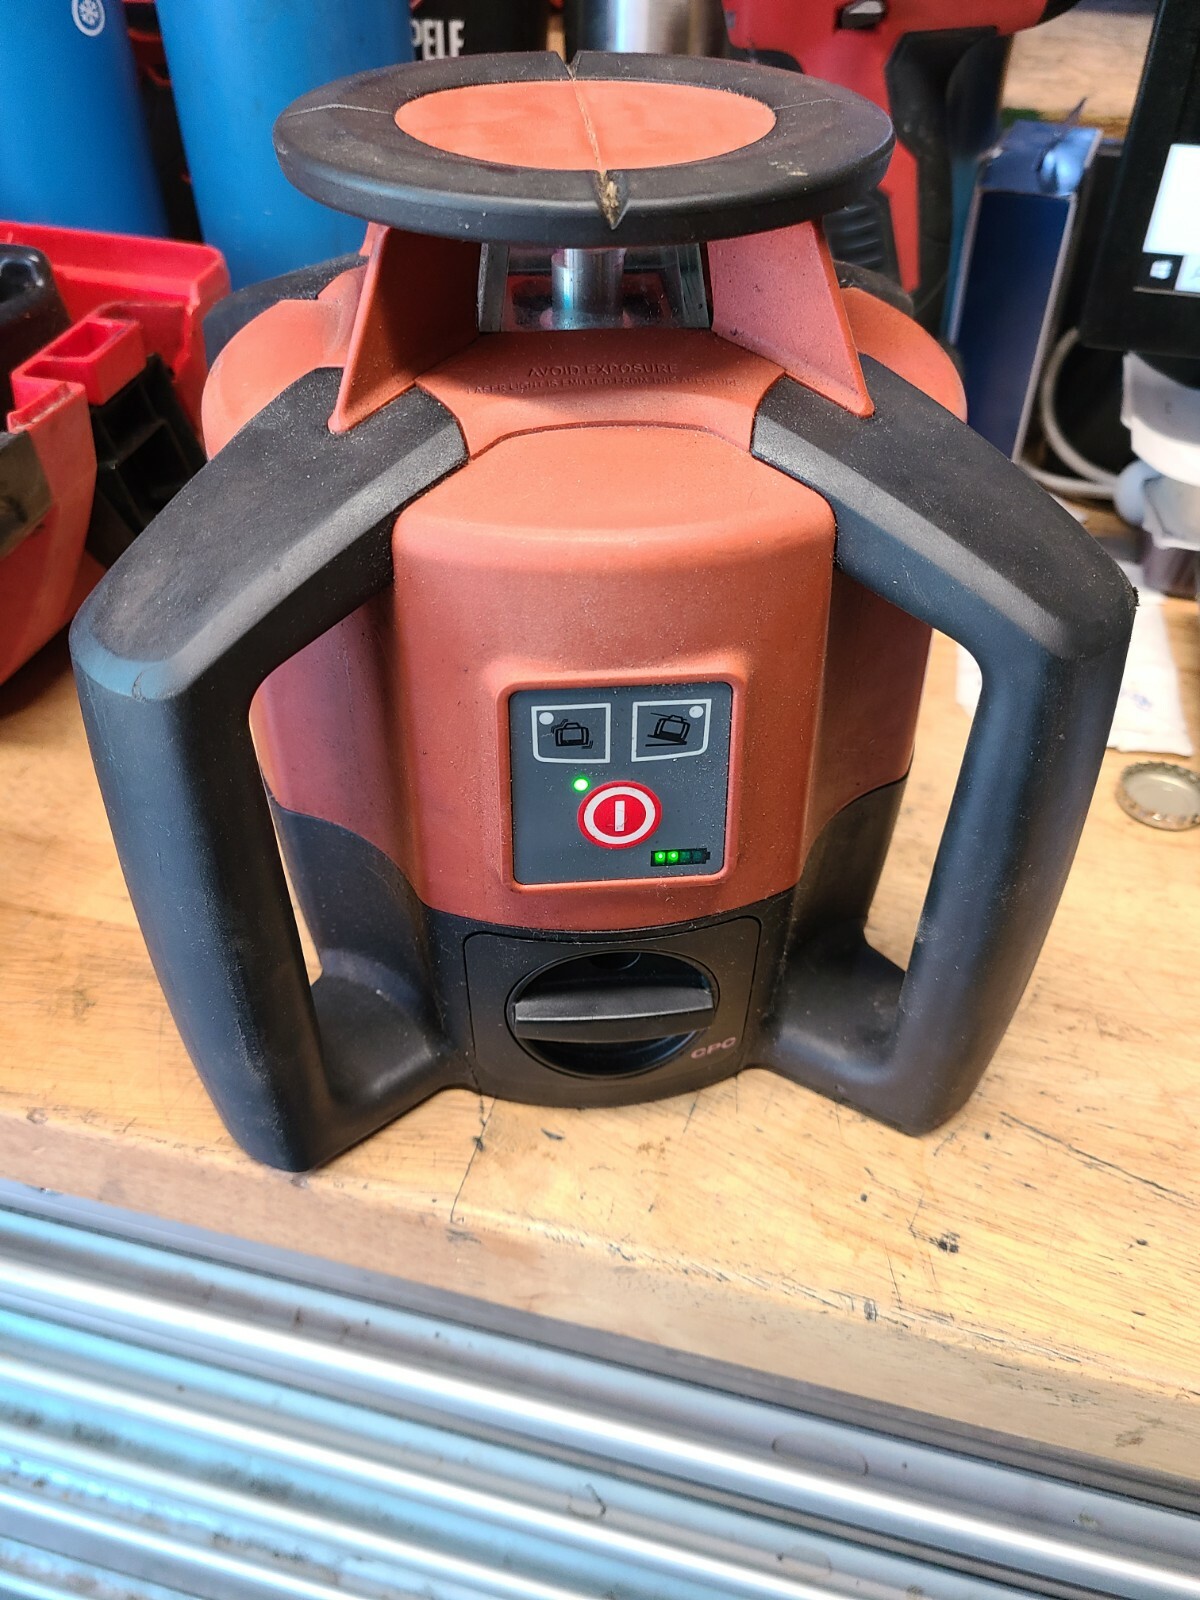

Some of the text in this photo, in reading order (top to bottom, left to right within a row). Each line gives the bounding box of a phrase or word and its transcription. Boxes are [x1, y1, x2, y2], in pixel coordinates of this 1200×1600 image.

[528, 362, 678, 378] AVOID EXPOSURE
[467, 383, 507, 395] LASER
[509, 380, 544, 391] LIGHT
[547, 378, 559, 388] IS
[562, 376, 612, 387] EMITTED
[616, 375, 648, 385] FROM
